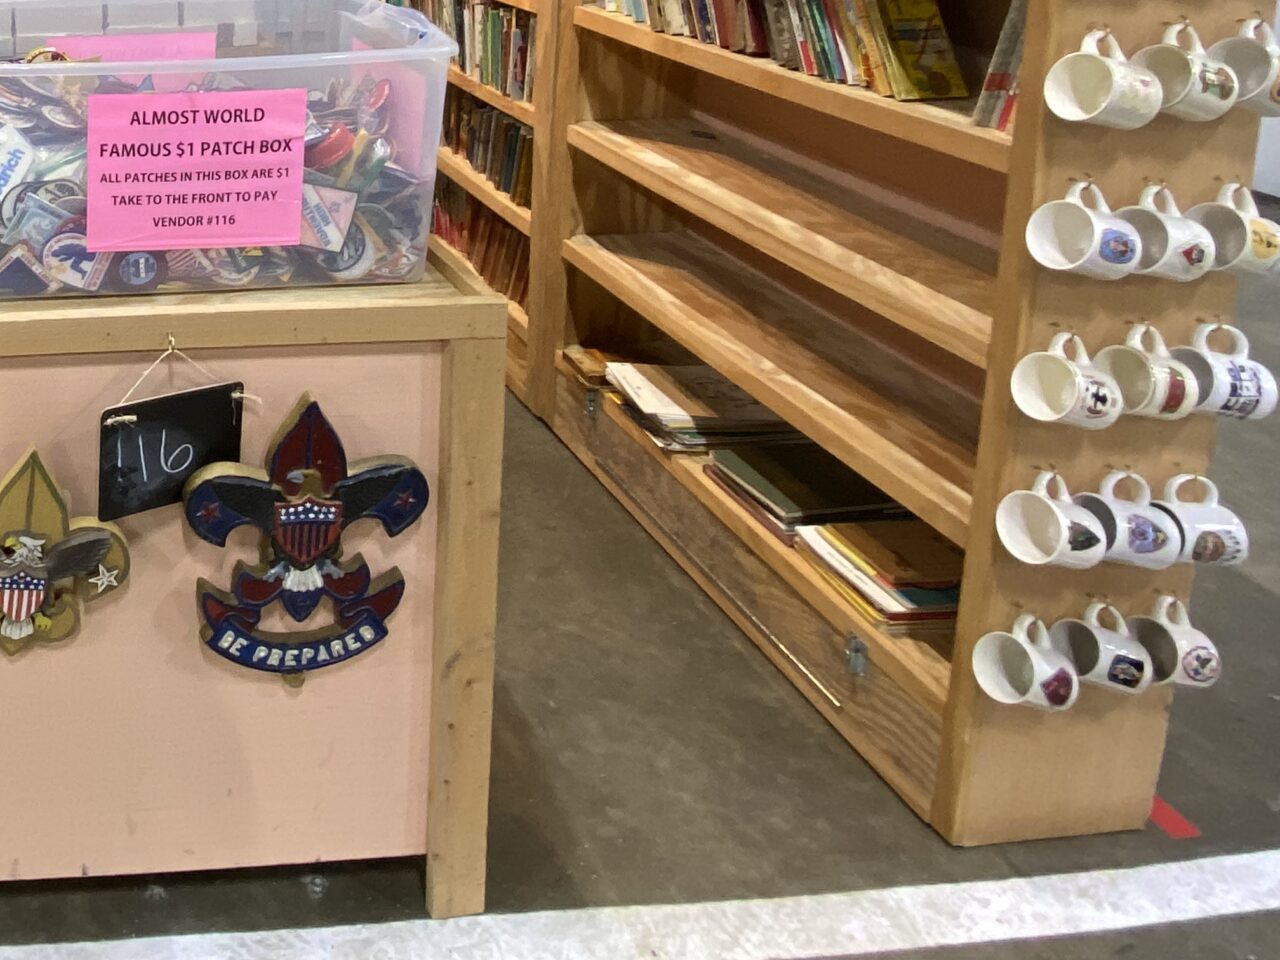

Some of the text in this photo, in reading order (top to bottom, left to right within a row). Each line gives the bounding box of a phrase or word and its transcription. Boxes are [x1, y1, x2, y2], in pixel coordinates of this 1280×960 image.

[130, 107, 266, 126] ALMOST WORLD
[99, 138, 293, 158] FAMOUS $1 PATCH BOX
[100, 167, 290, 184] ALL PATCHES IN THIS BOX ARE $1
[112, 190, 278, 206] TAKE TO THE FRONT TO PAY
[152, 214, 236, 228] VENDOR #116
[116, 427, 194, 482] 116
[217, 625, 376, 666] BE PREPARED
